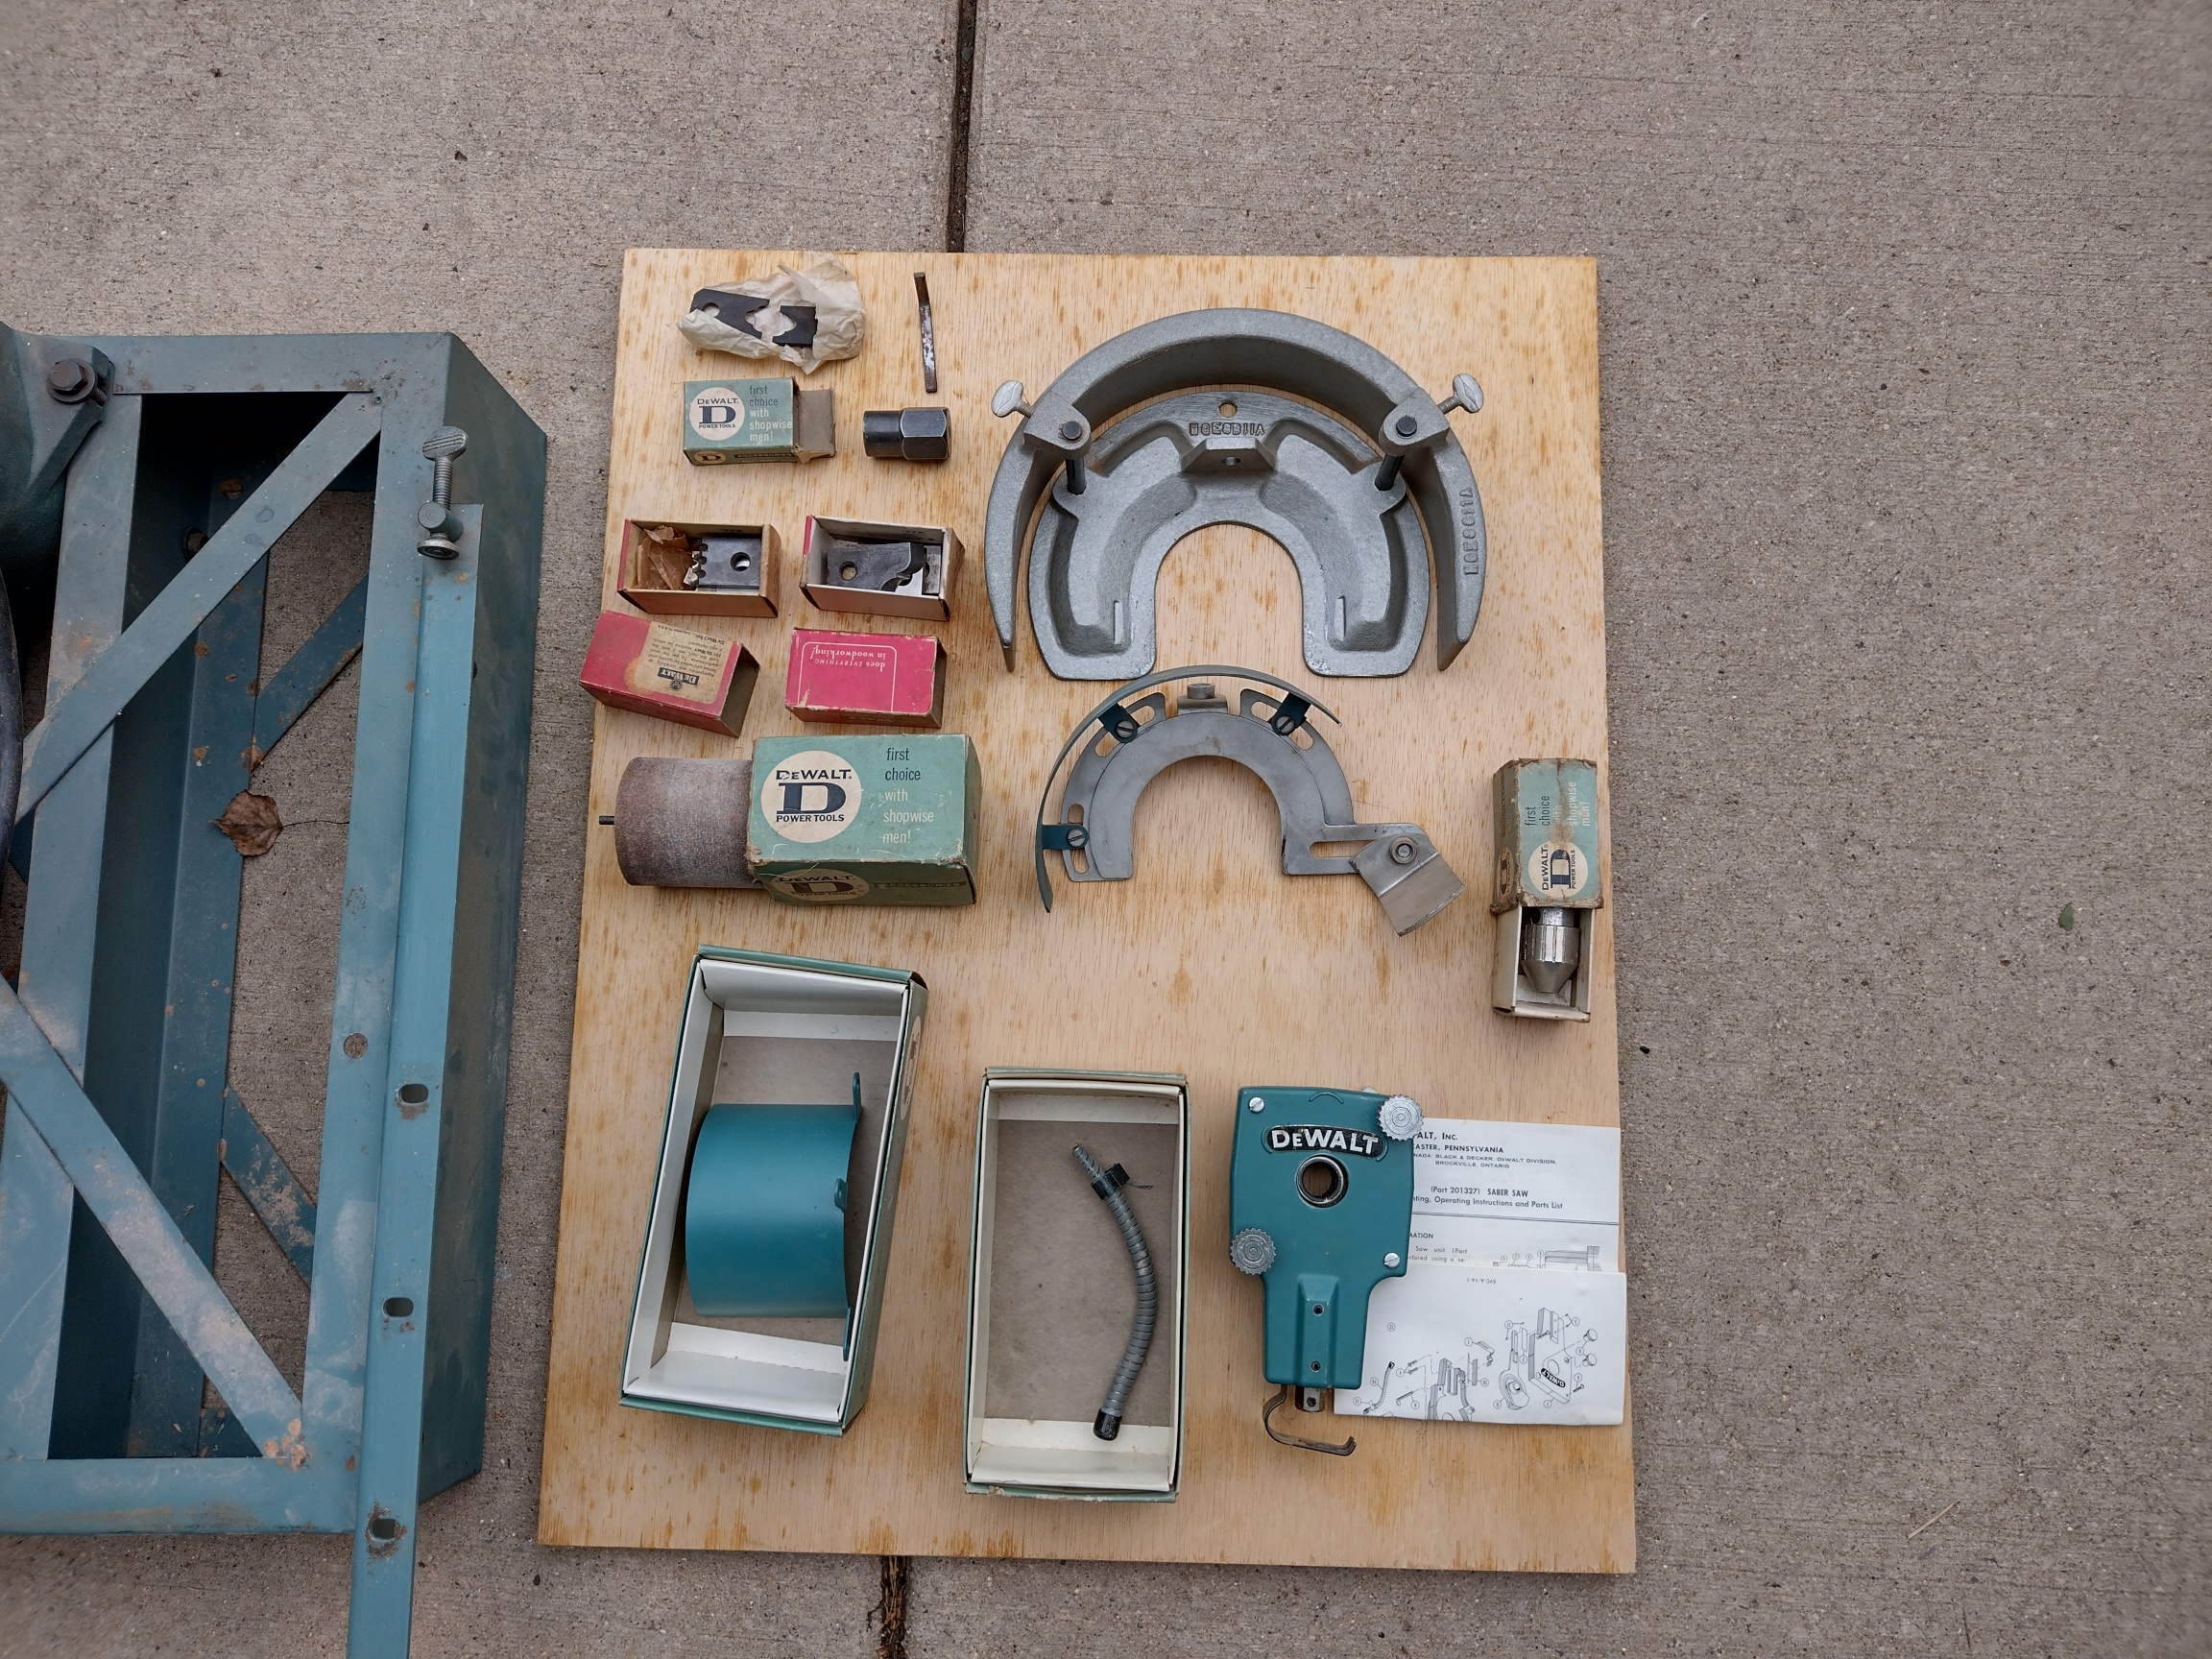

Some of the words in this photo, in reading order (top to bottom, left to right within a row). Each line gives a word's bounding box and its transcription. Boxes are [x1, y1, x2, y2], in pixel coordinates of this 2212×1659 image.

[749, 385, 768, 395] first
[749, 397, 779, 407] choice
[699, 405, 736, 423] D
[750, 407, 769, 418] with
[749, 419, 792, 431] shopwise
[750, 431, 774, 443] men!
[810, 645, 875, 661] woodworking!
[814, 659, 863, 667] EVERYTHING
[866, 661, 886, 672] does
[886, 747, 910, 761] first
[885, 767, 921, 781] choice
[776, 781, 847, 814] D
[884, 788, 908, 802] with
[1567, 781, 1576, 827] shopwise
[883, 808, 934, 824] shopwise
[1525, 805, 1536, 827] first
[1539, 795, 1551, 827] choice
[776, 813, 812, 823] POWER
[814, 813, 845, 822] TOOLS
[882, 831, 911, 844] men!
[1417, 1132, 1437, 1141] ALT,
[1434, 1196, 1471, 1206] Operating
[1473, 1196, 1513, 1207] Instructions
